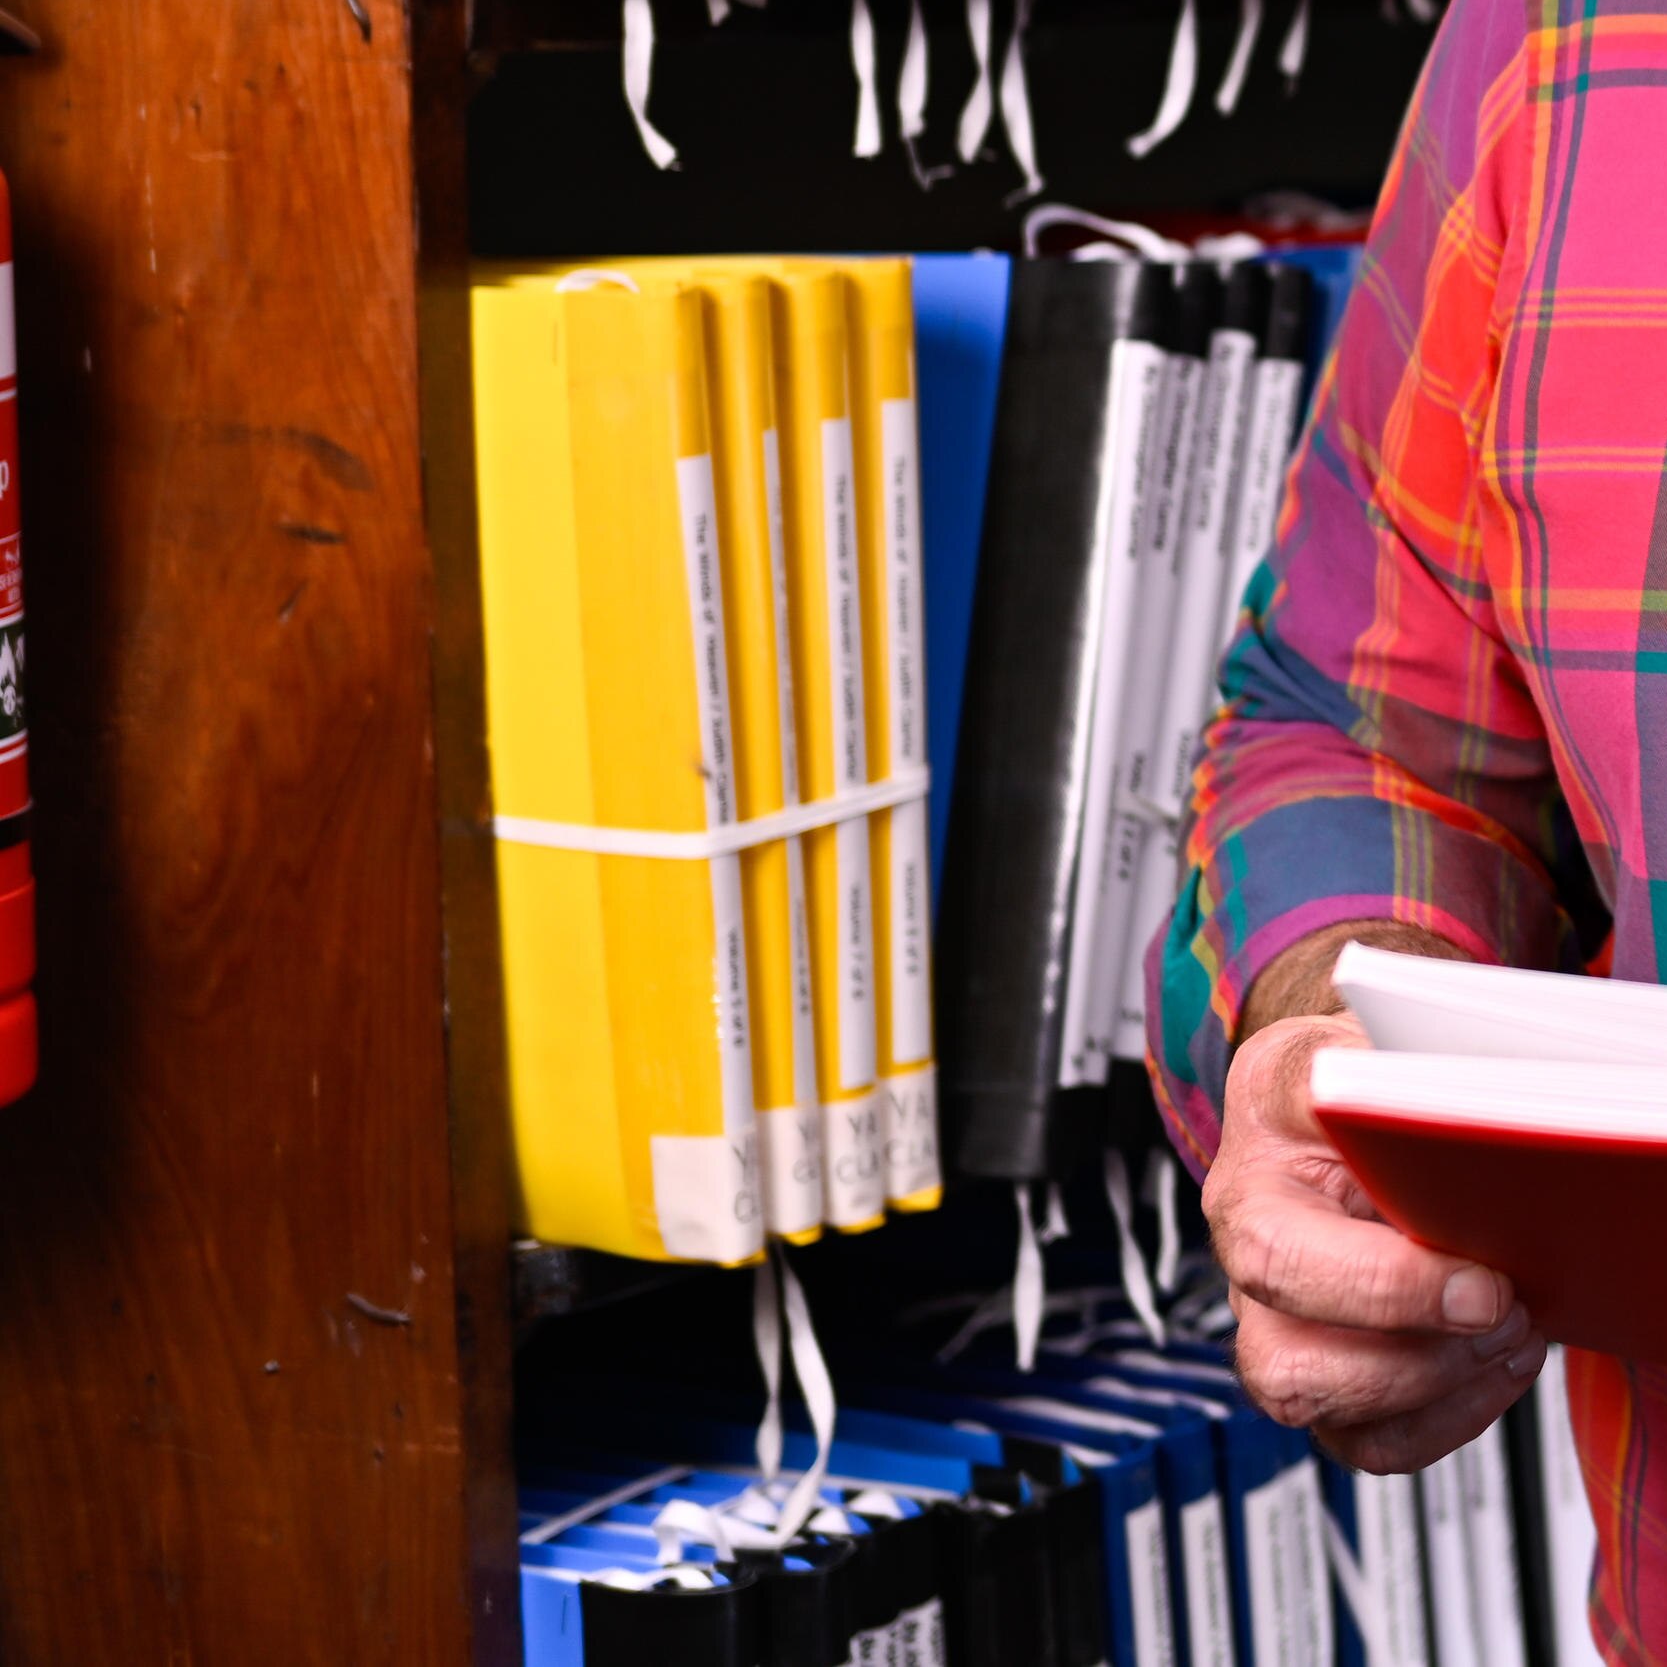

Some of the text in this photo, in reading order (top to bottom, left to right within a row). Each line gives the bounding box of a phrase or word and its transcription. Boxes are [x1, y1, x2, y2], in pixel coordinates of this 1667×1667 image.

[892, 456, 909, 487] The
[834, 474, 851, 506] The
[693, 512, 711, 545] The
[894, 492, 910, 542] Winds
[836, 510, 853, 561] Winds
[895, 546, 910, 565] of
[697, 551, 717, 603] Winds
[838, 567, 855, 585] of
[701, 607, 718, 626] of
[727, 926, 742, 993] Volume
[731, 1015, 746, 1032] of
[847, 1110, 878, 1135] YA
